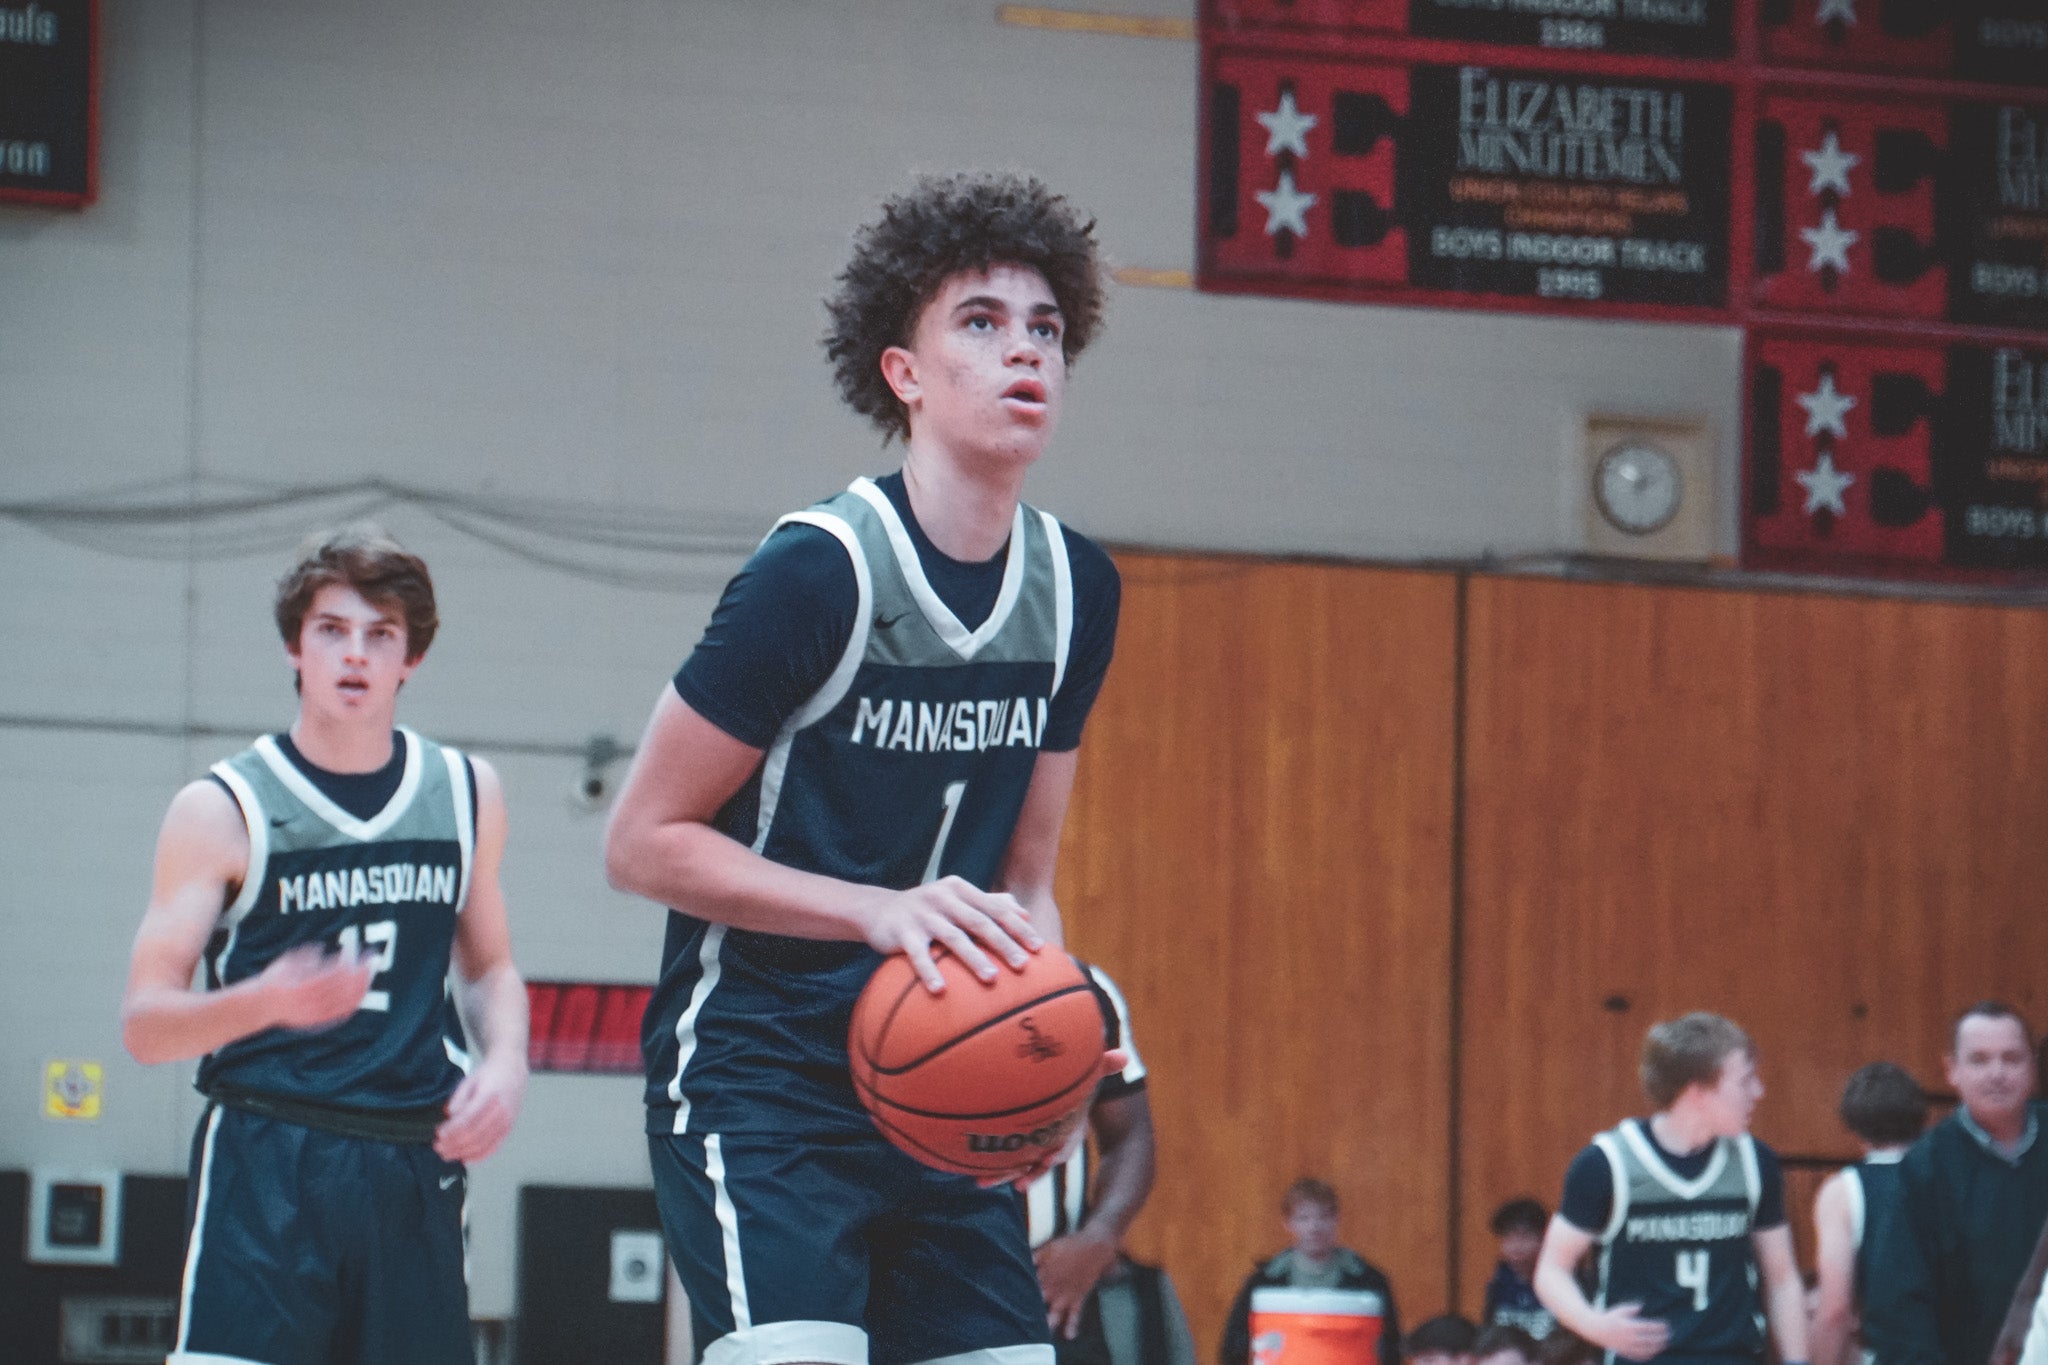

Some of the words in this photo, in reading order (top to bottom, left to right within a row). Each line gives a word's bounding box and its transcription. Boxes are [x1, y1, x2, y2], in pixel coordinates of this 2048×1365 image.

[1459, 65, 1685, 146] ELIZABETH
[1457, 128, 1682, 183] MINUTEMEN
[1430, 225, 1502, 260] BOYS
[1506, 232, 1617, 267] INDOOR
[1620, 238, 1706, 273] TRACK
[921, 780, 968, 886] 1
[279, 862, 456, 915] MANASQUAN
[1675, 1248, 1710, 1312] 4
